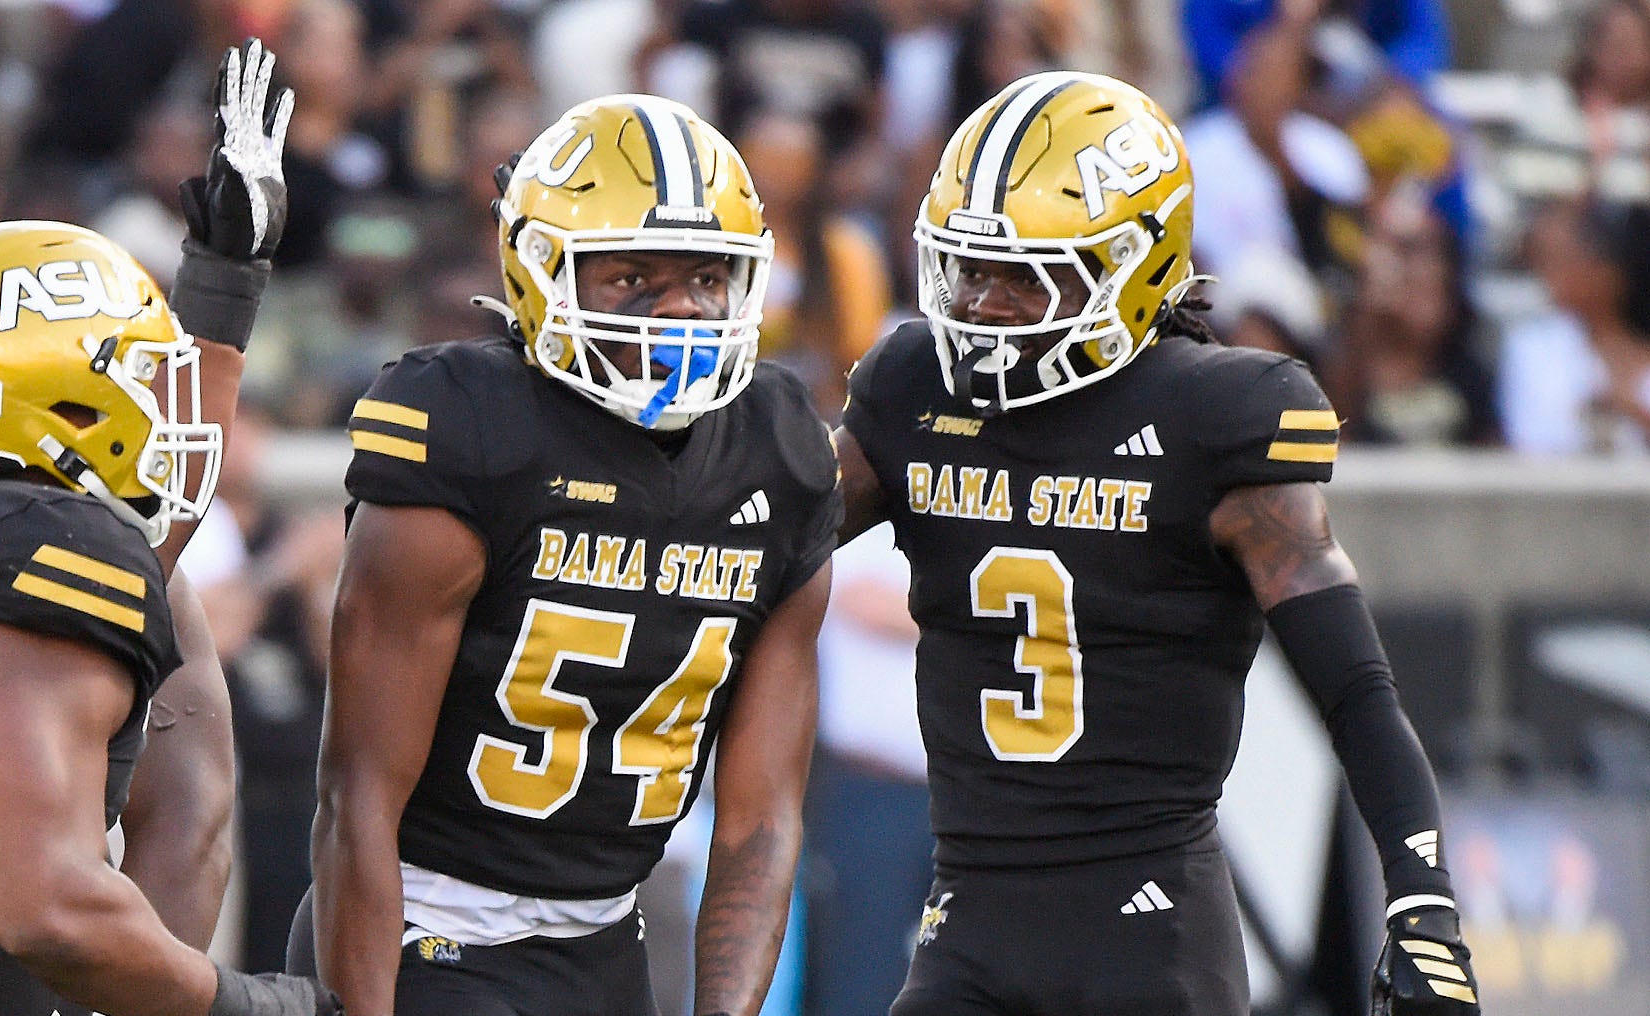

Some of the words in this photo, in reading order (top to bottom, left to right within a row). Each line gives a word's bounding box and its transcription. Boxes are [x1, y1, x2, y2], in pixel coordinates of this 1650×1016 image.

[1074, 112, 1179, 222] ASU
[906, 461, 1013, 522] BAMA
[1028, 475, 1153, 532] STATE
[532, 527, 647, 591] BAMA
[655, 543, 764, 602] STATE
[969, 546, 1085, 762] 3
[467, 597, 738, 827] 54
